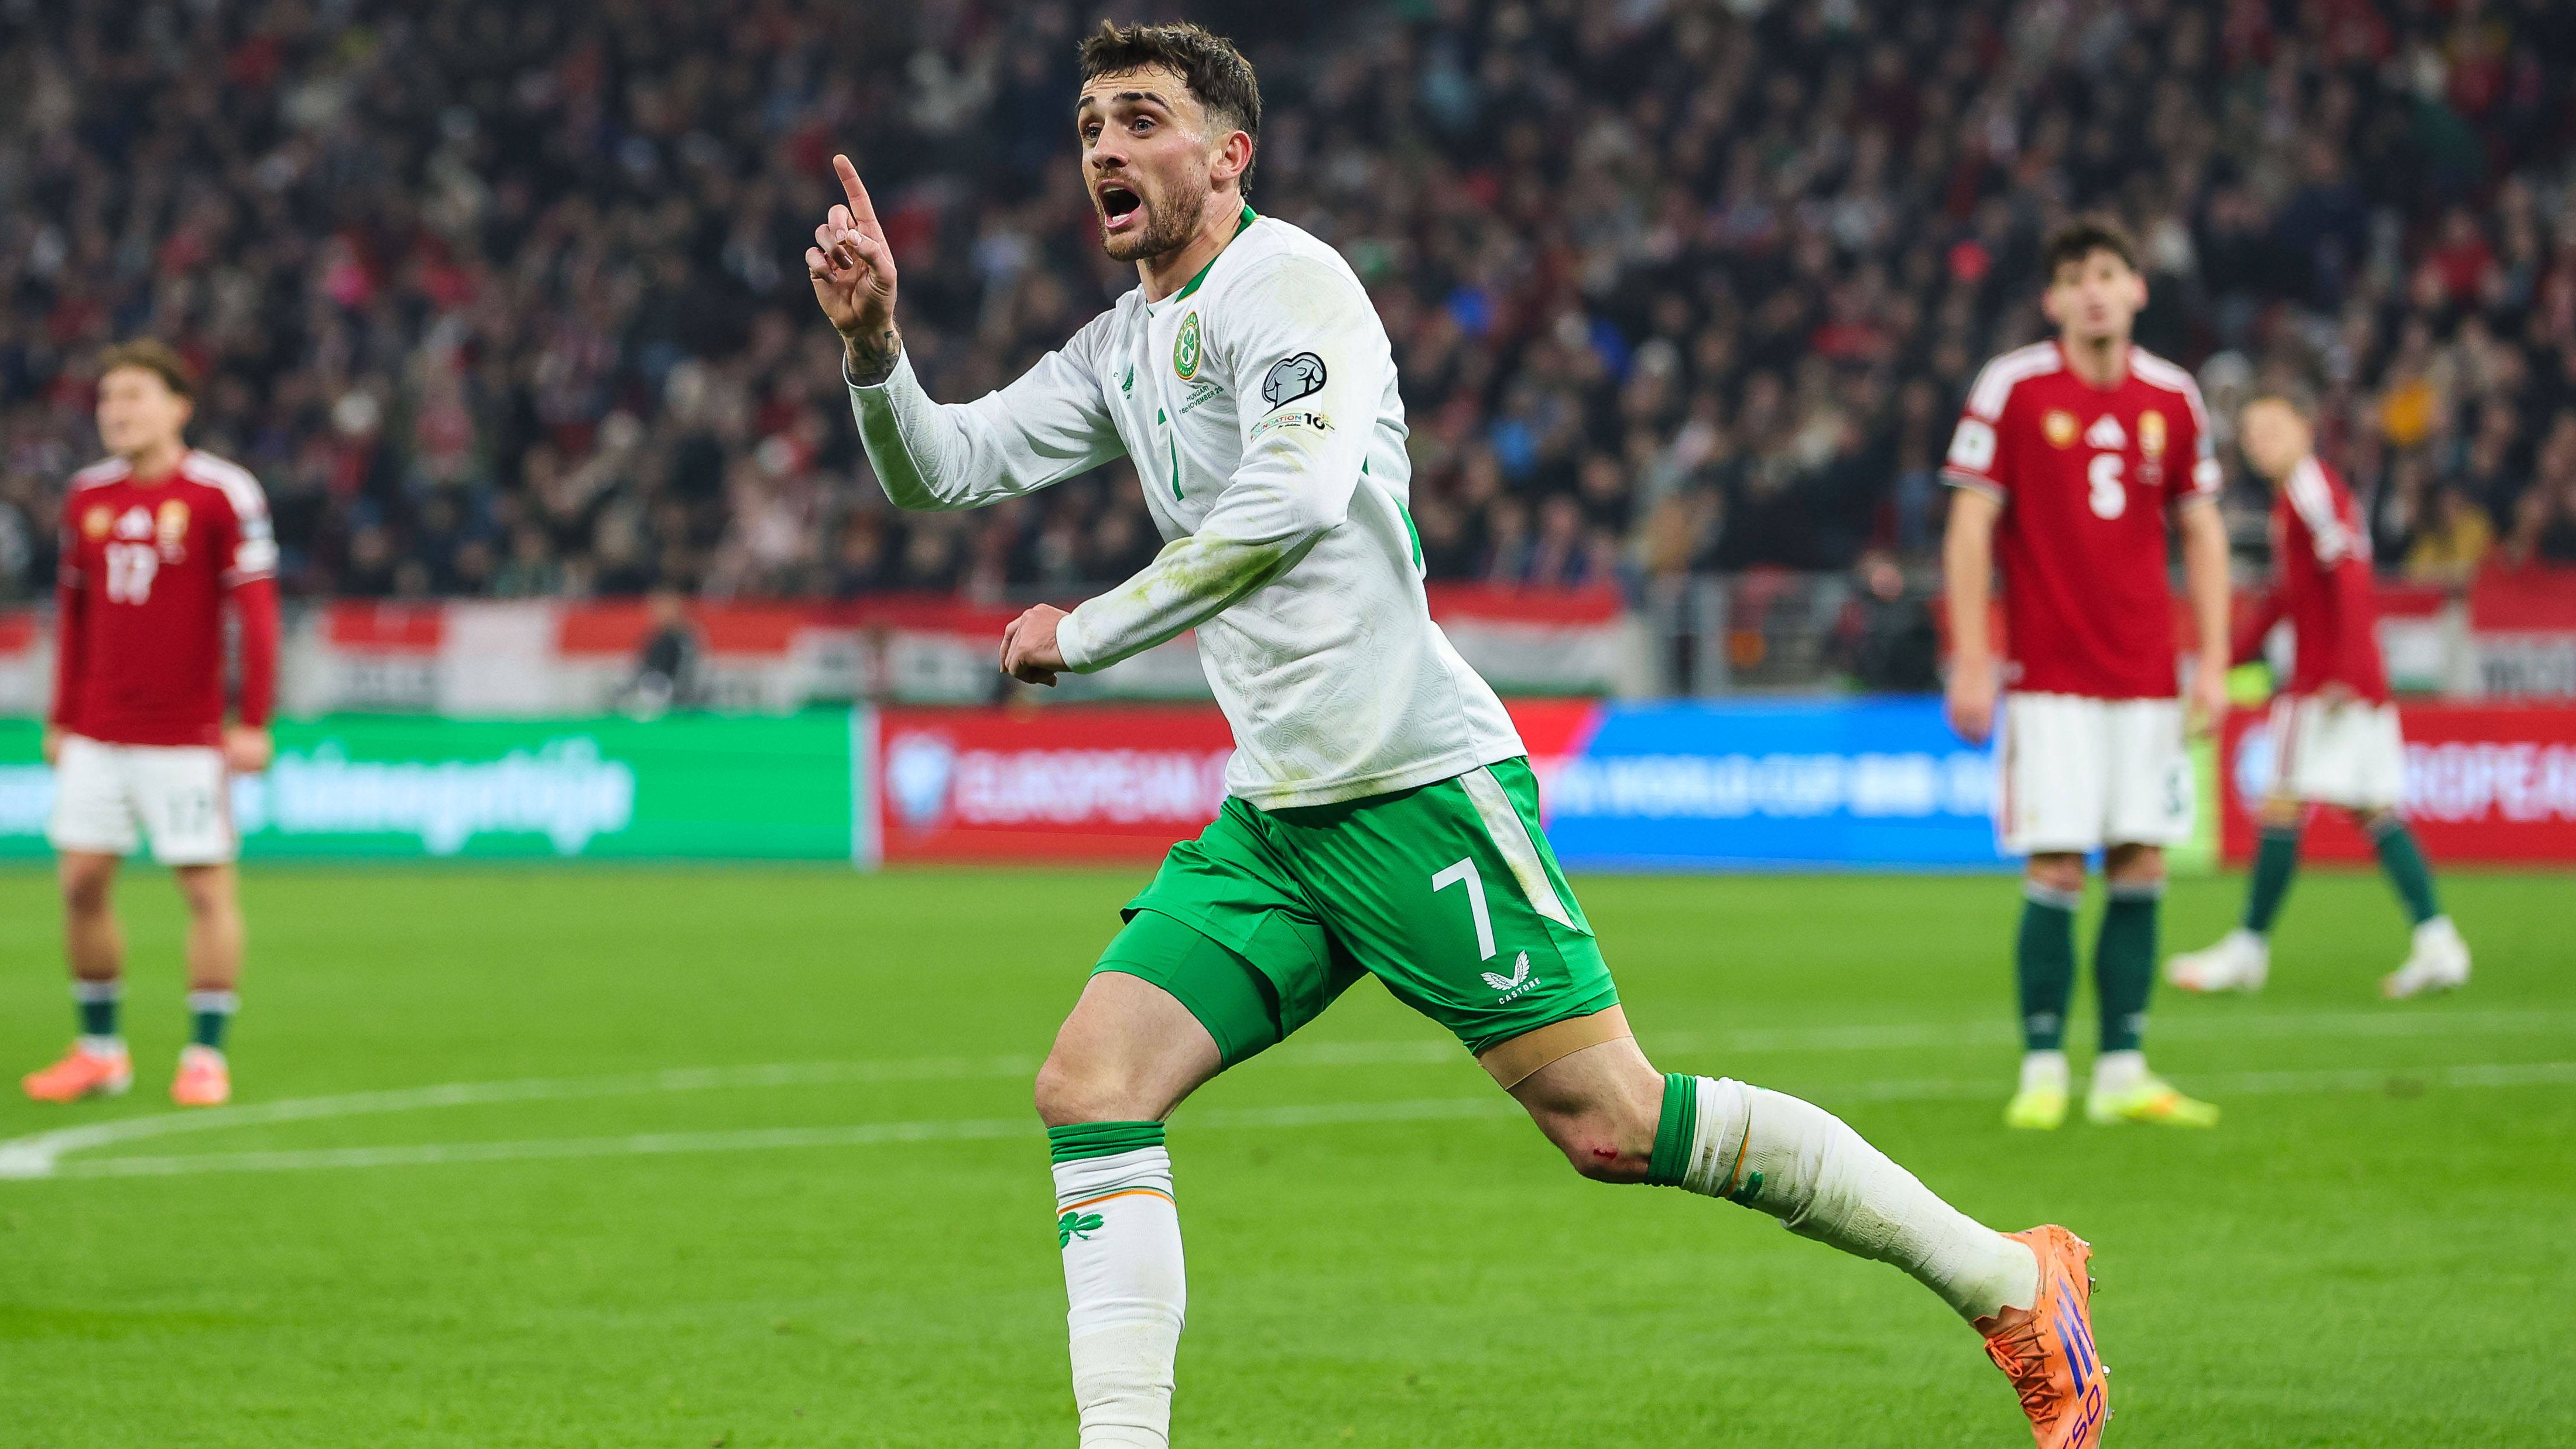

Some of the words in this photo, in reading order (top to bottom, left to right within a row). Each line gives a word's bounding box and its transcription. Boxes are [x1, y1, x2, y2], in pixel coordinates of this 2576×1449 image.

[1186, 384, 1210, 402] HUNGARY
[2087, 452, 2127, 520] 5
[1431, 856, 1497, 961] 7
[1498, 977, 1542, 1005] CASTORE
